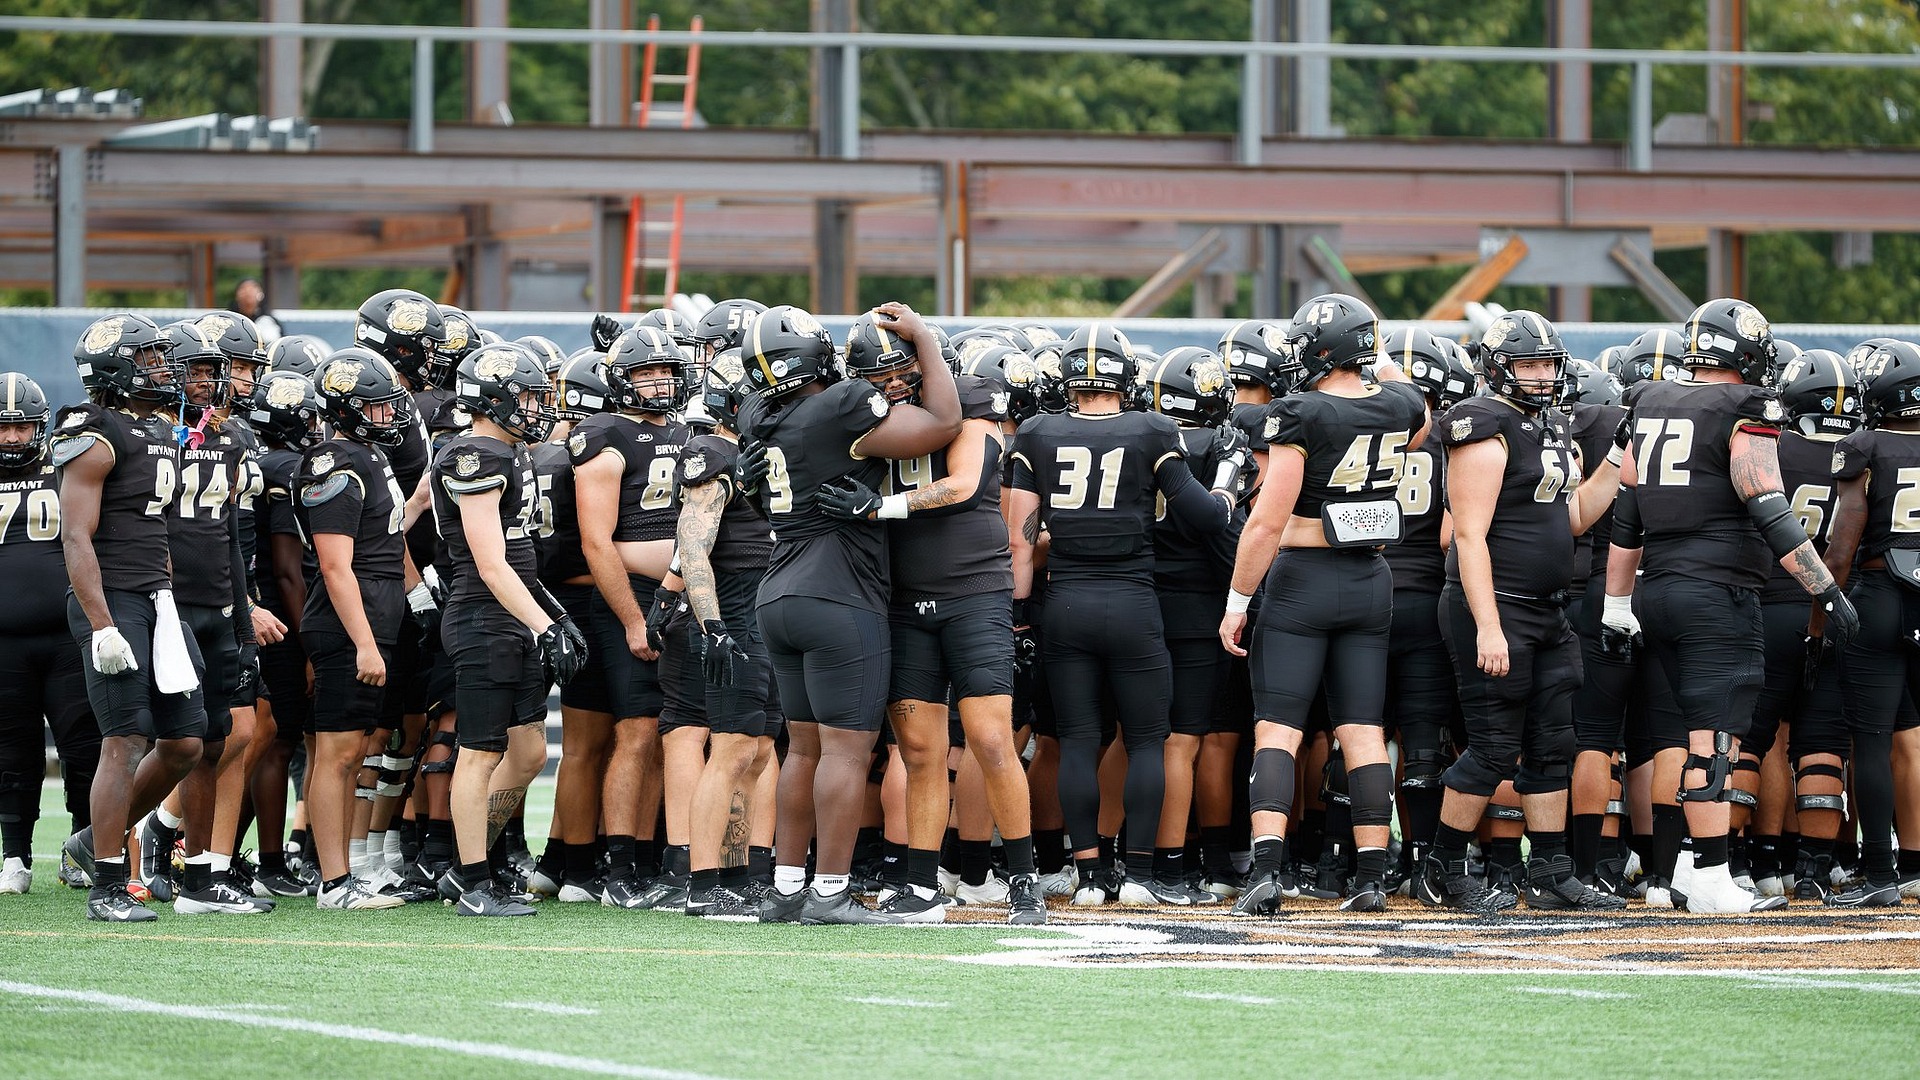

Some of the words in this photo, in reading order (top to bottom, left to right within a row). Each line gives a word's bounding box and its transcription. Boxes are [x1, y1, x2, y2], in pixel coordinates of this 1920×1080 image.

[727, 308, 757, 330] 58
[1306, 302, 1336, 326] 45
[1705, 358, 1719, 366] WIN
[1865, 353, 1891, 376] 23
[778, 384, 787, 392] TO
[788, 379, 803, 389] WIN
[1104, 381, 1118, 389] WIN
[1237, 373, 1251, 382] WIN
[147, 445, 177, 458] BRYANT
[184, 449, 224, 461] BRYANT
[1327, 431, 1409, 493] 45
[1635, 417, 1695, 486] 72
[0, 480, 44, 491] BRYANT
[145, 458, 177, 515] 9
[1050, 446, 1125, 510] 31
[180, 462, 229, 520] 14
[0, 489, 61, 545] 70
[1790, 484, 1841, 543] 6
